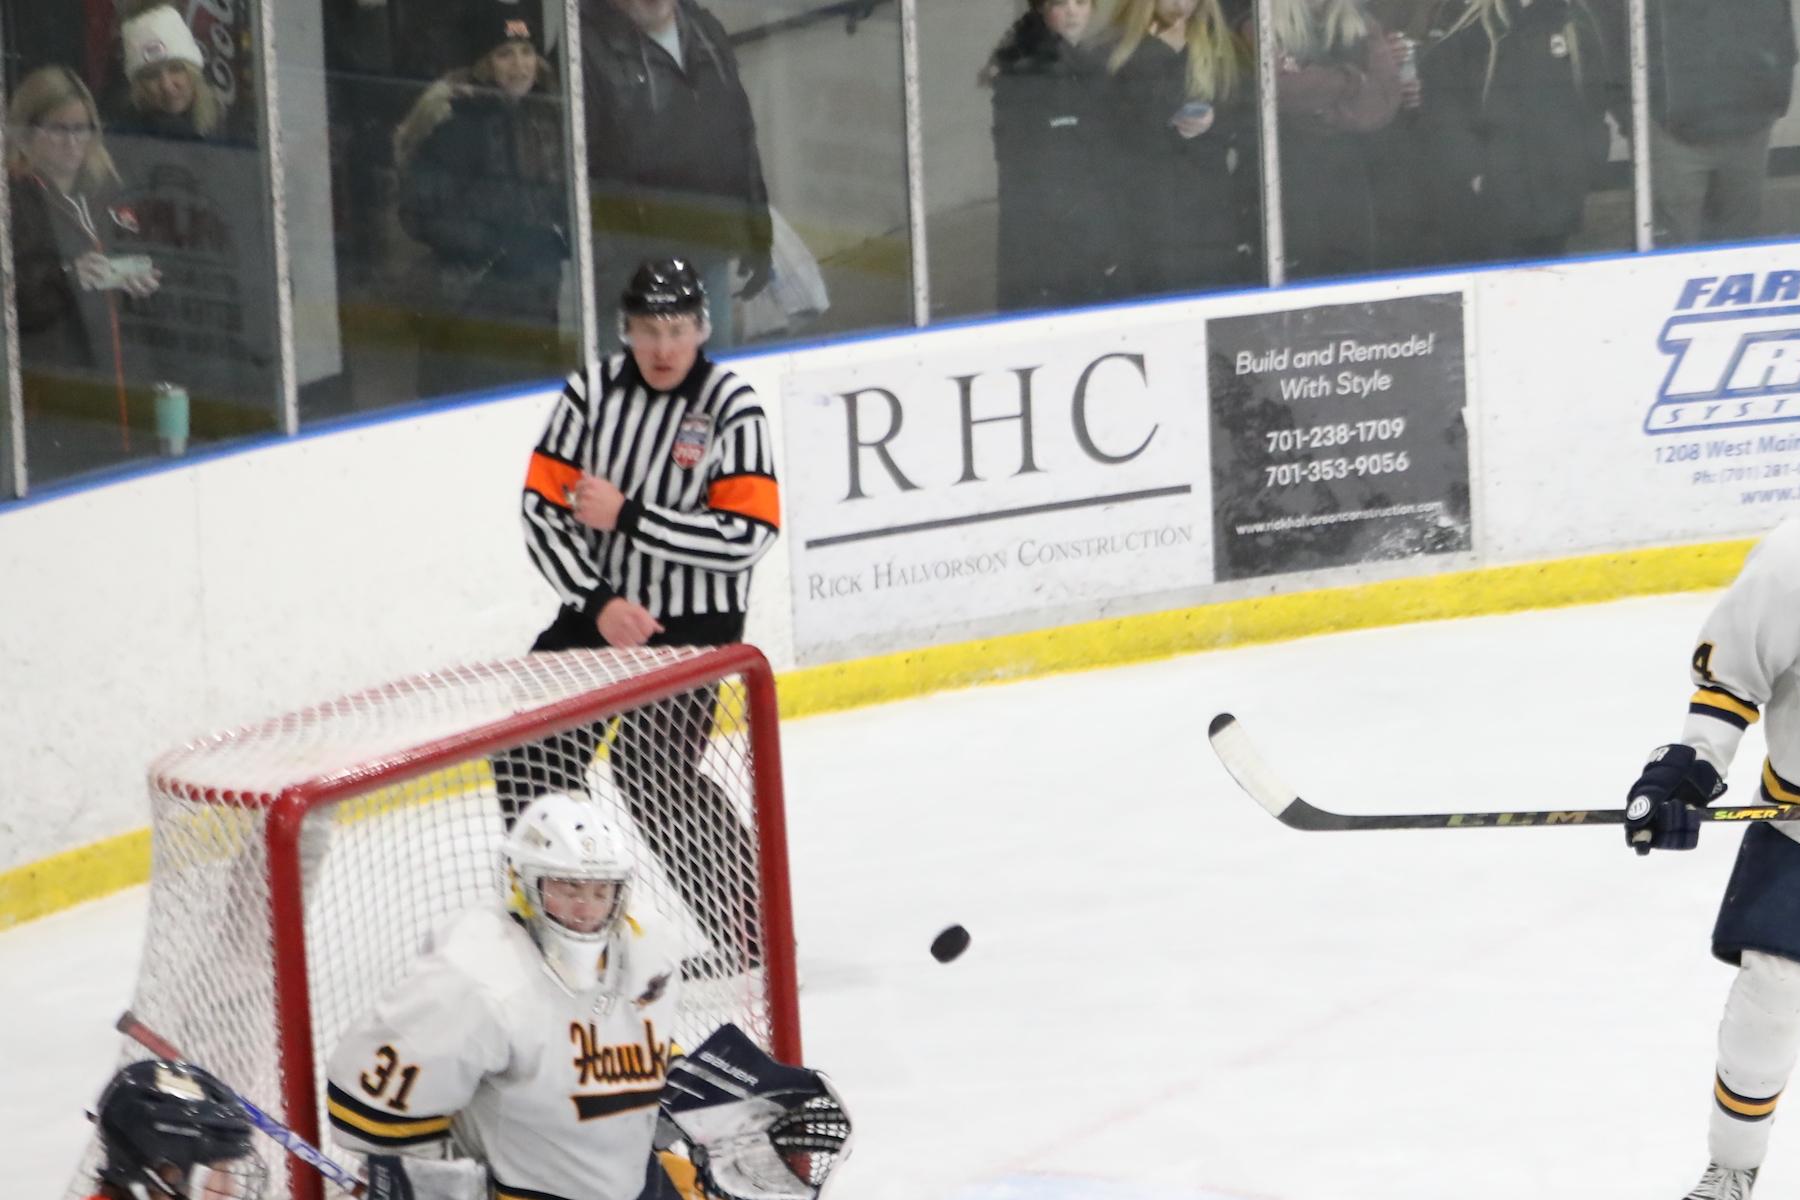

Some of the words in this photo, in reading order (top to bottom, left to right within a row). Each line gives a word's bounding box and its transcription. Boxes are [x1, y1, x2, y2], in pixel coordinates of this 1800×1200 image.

[1235, 348, 1290, 375] Build
[1293, 342, 1335, 369] and
[1338, 332, 1436, 364] Remodel
[1280, 374, 1331, 401] With
[1335, 369, 1393, 398] Style
[1266, 417, 1406, 453] 701-238-1709
[1655, 443, 1700, 464] 1208
[1706, 438, 1753, 459] West
[1265, 451, 1411, 488] 701-353-9056
[872, 551, 1007, 591] HALVORSON
[1017, 525, 1193, 567] CONSTRUCTION
[1692, 642, 1717, 684] 4
[1713, 808, 1779, 821] SUPER
[569, 1017, 666, 1085] Hawk
[699, 1051, 759, 1086] BAUER
[359, 1044, 419, 1110] 31
